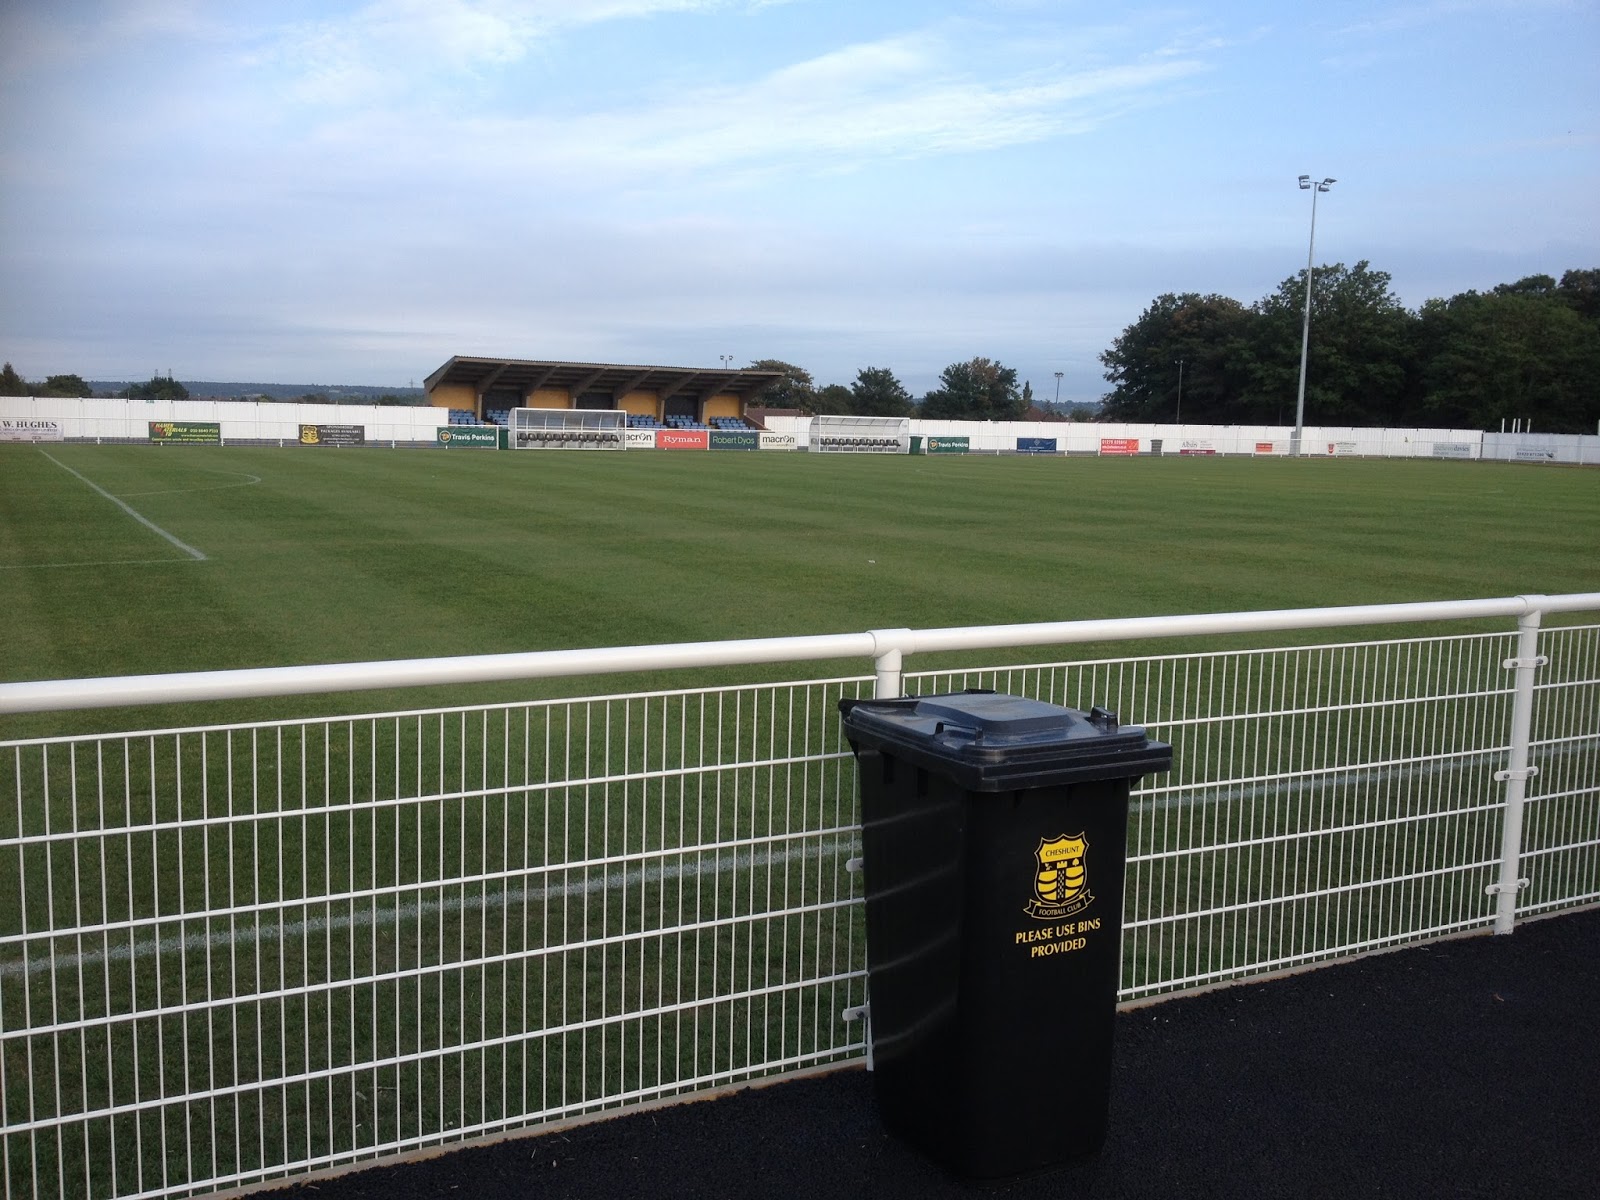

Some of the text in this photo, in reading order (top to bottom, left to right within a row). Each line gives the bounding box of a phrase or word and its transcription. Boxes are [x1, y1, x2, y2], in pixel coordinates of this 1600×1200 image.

[663, 435, 701, 444] Ryman
[712, 435, 737, 444] Robert
[1045, 846, 1080, 857] CHESHUNT
[1038, 903, 1082, 916] FOOTBALL CLUB
[1015, 917, 1101, 944] PLEASE USE BINS
[1031, 937, 1086, 958] PROVIDED
